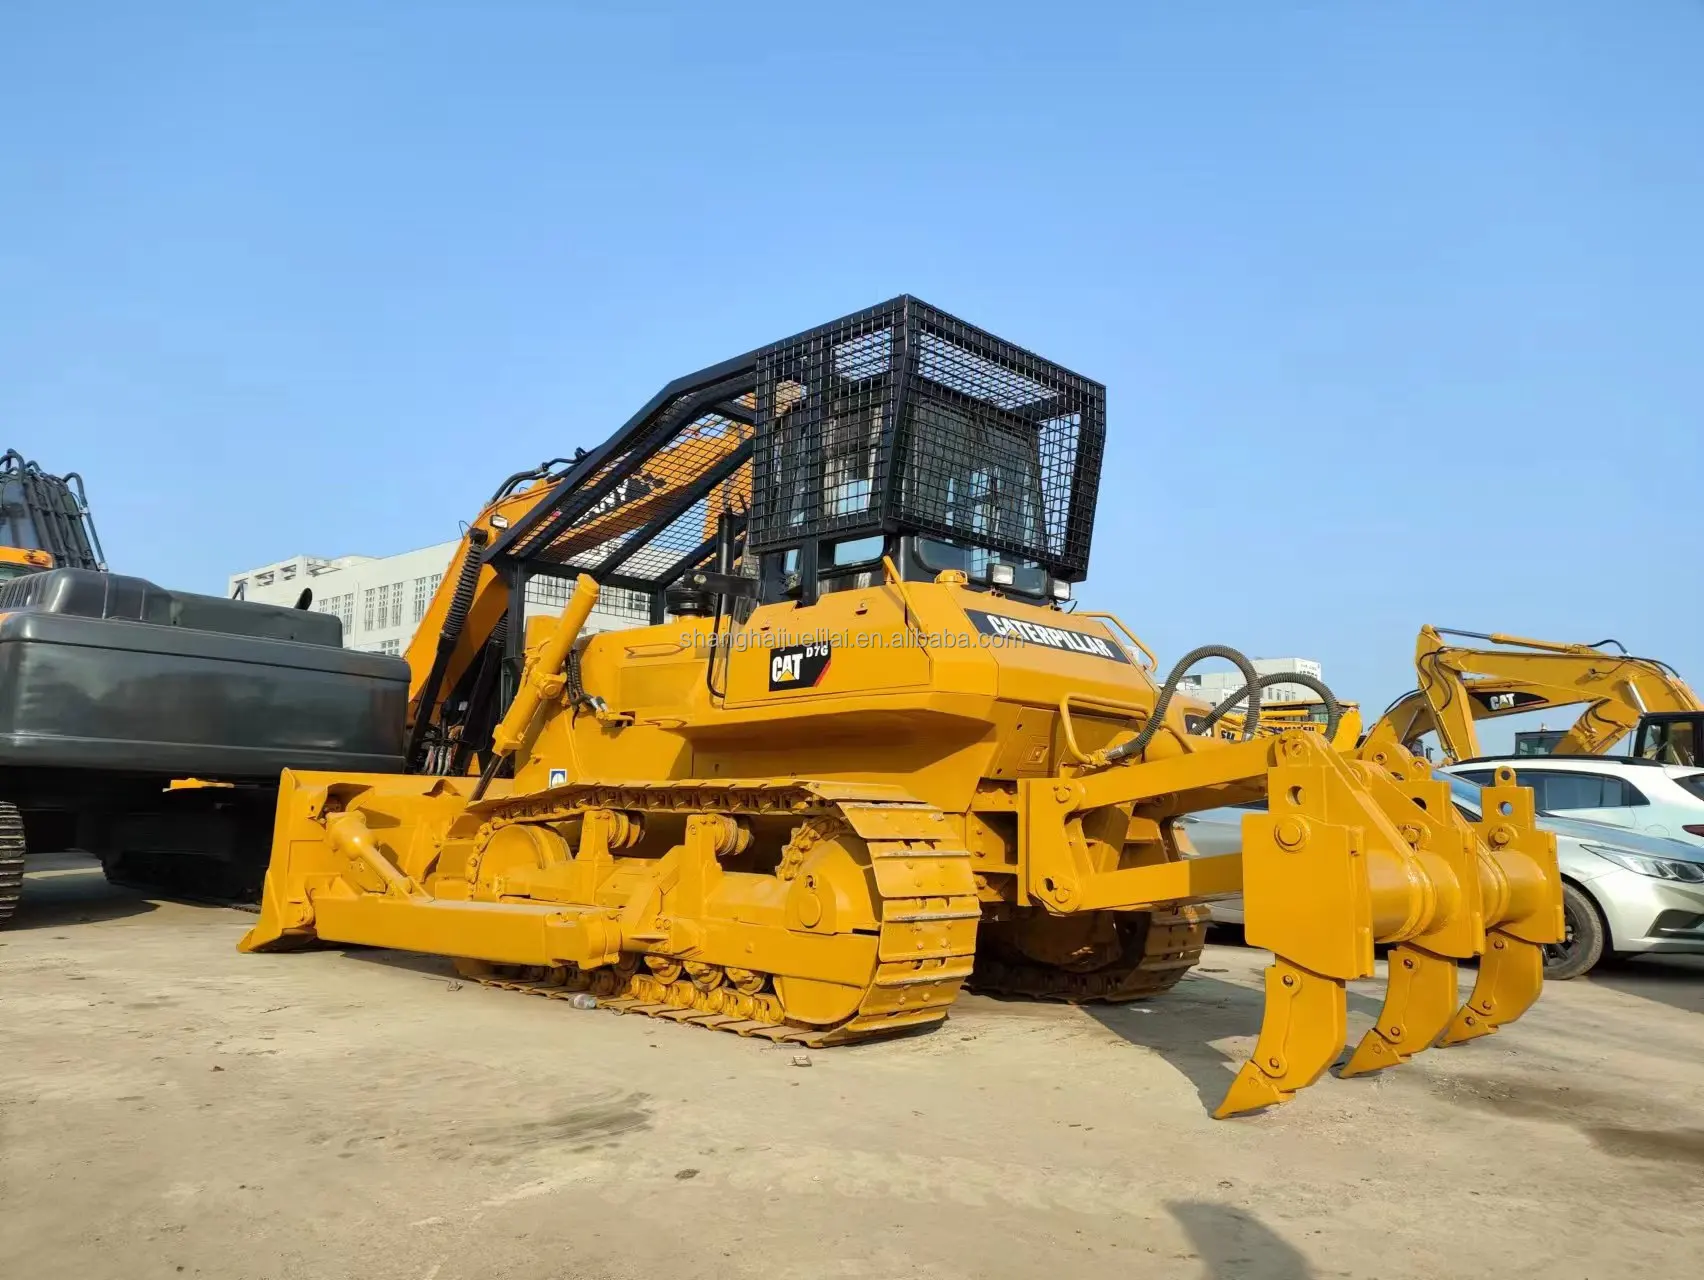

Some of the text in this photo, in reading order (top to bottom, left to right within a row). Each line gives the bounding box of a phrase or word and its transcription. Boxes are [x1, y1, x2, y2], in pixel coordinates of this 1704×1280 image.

[986, 614, 1116, 658] CATERPILLAR
[771, 645, 829, 682] CAT D7G
[1490, 693, 1515, 710] CAT
